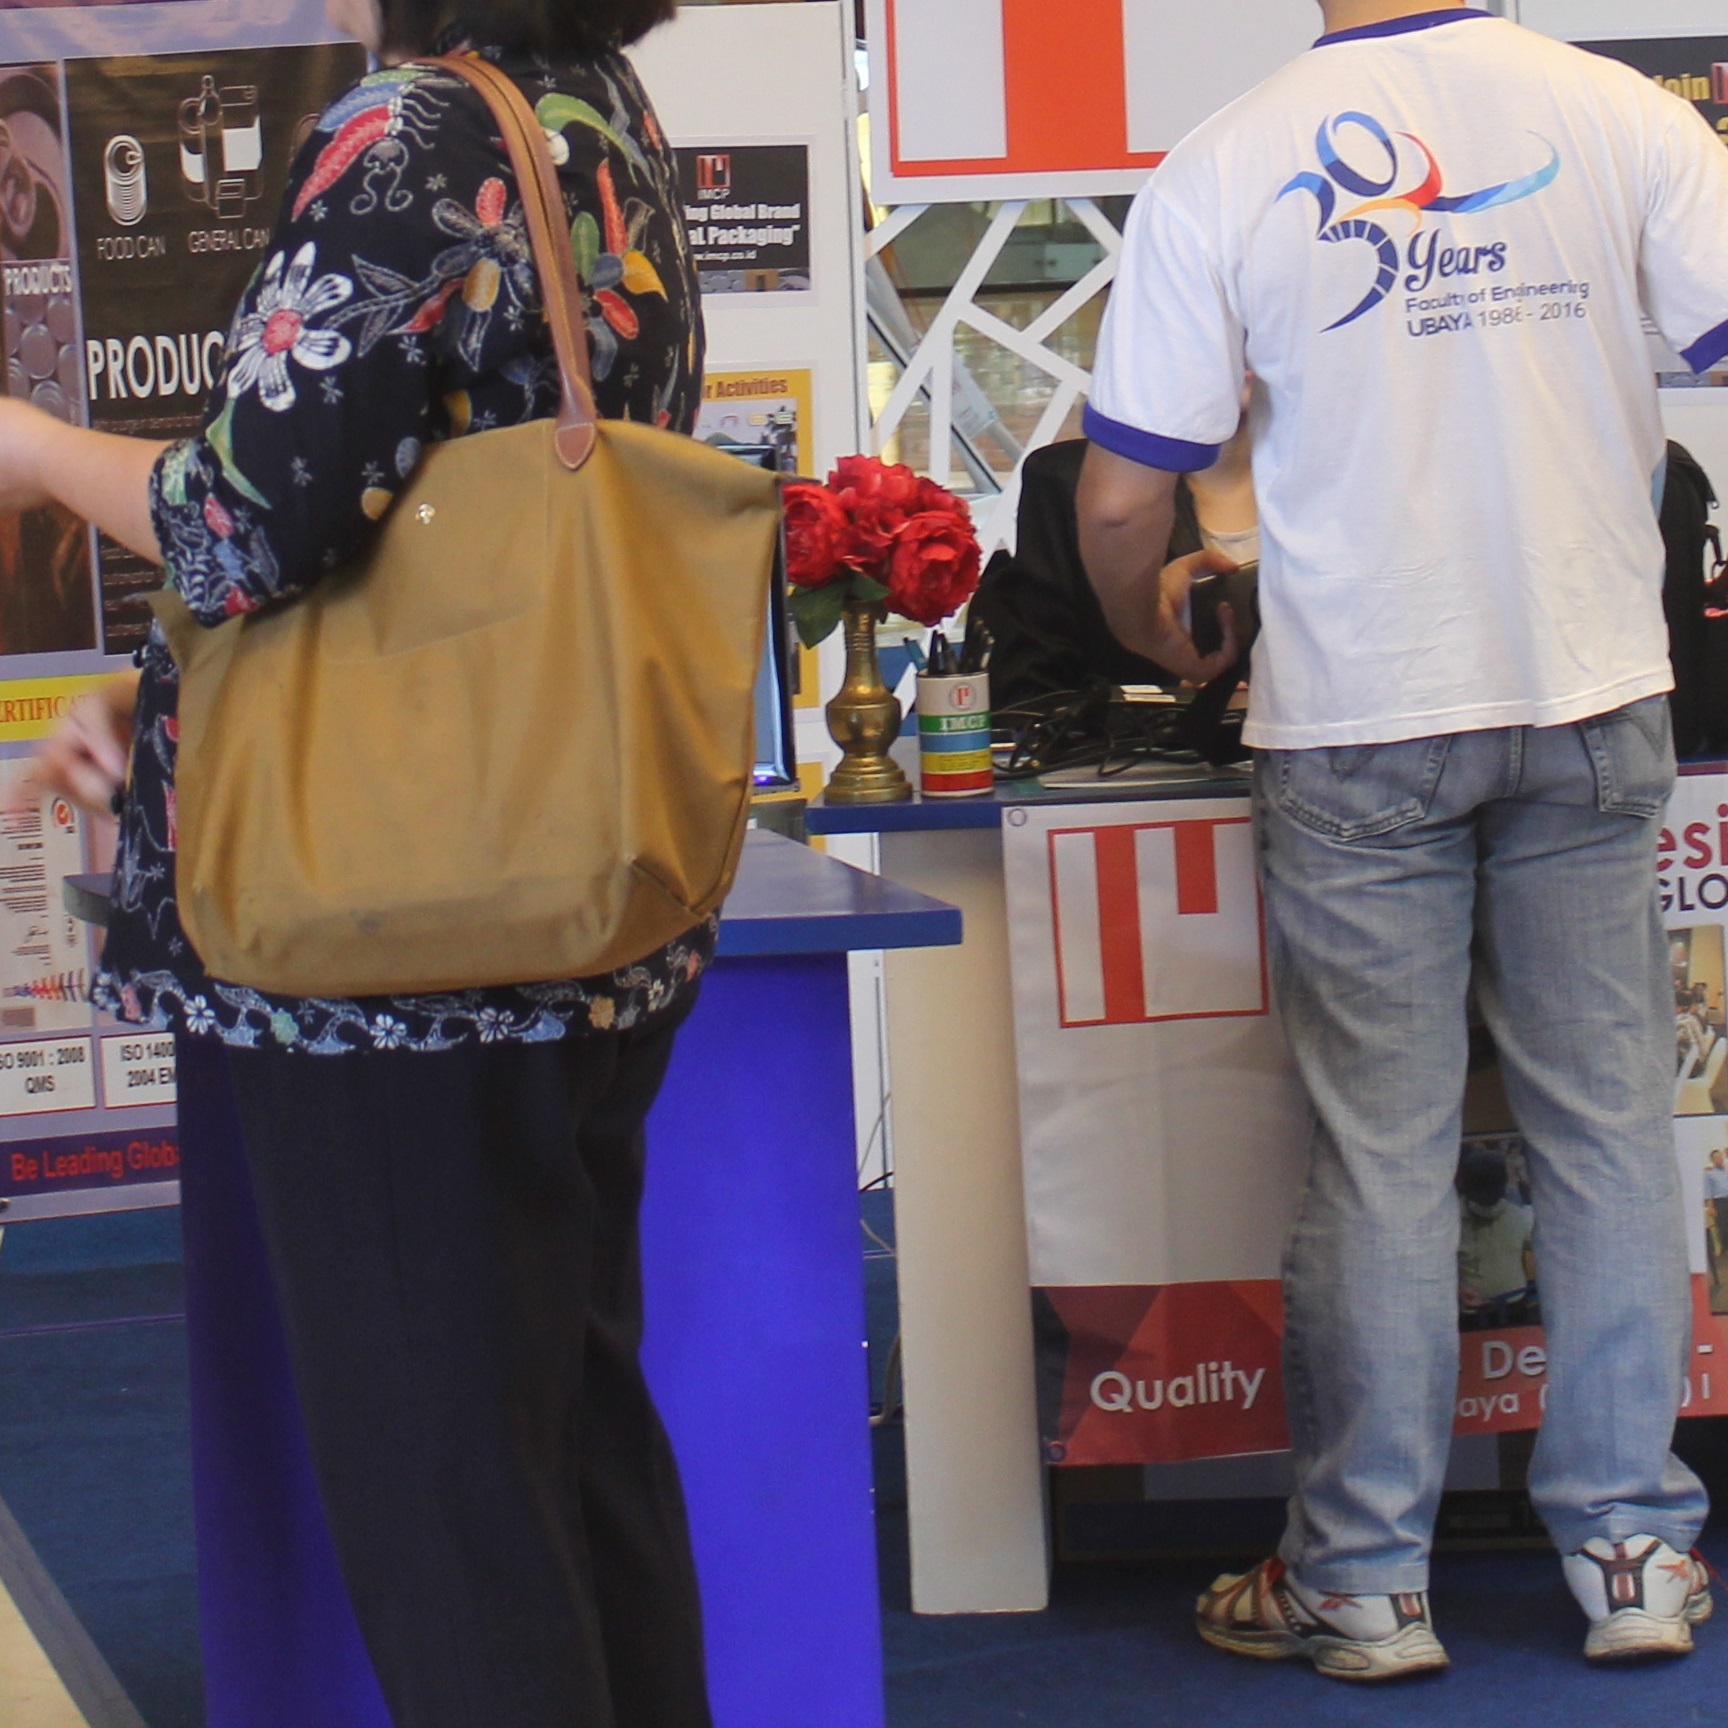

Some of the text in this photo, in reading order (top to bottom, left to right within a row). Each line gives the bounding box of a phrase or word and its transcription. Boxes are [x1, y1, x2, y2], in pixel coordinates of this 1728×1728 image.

[710, 204, 756, 220] Global
[758, 203, 801, 219] Brand
[97, 235, 166, 258] FOOD CAN
[1405, 229, 1506, 292] Years
[5, 263, 72, 296] PRODUCTS
[1468, 289, 1486, 303] of
[1540, 302, 1586, 320] 2016
[87, 331, 226, 400] PRODUC
[717, 379, 788, 398] Activities
[17, 1050, 44, 1068] 9001
[120, 1041, 175, 1062] ISO 1400
[25, 1075, 55, 1094] QMS
[127, 1070, 155, 1087] 2004
[11, 1140, 179, 1181] Be Leading Glob
[1089, 1360, 1266, 1414] Quality
